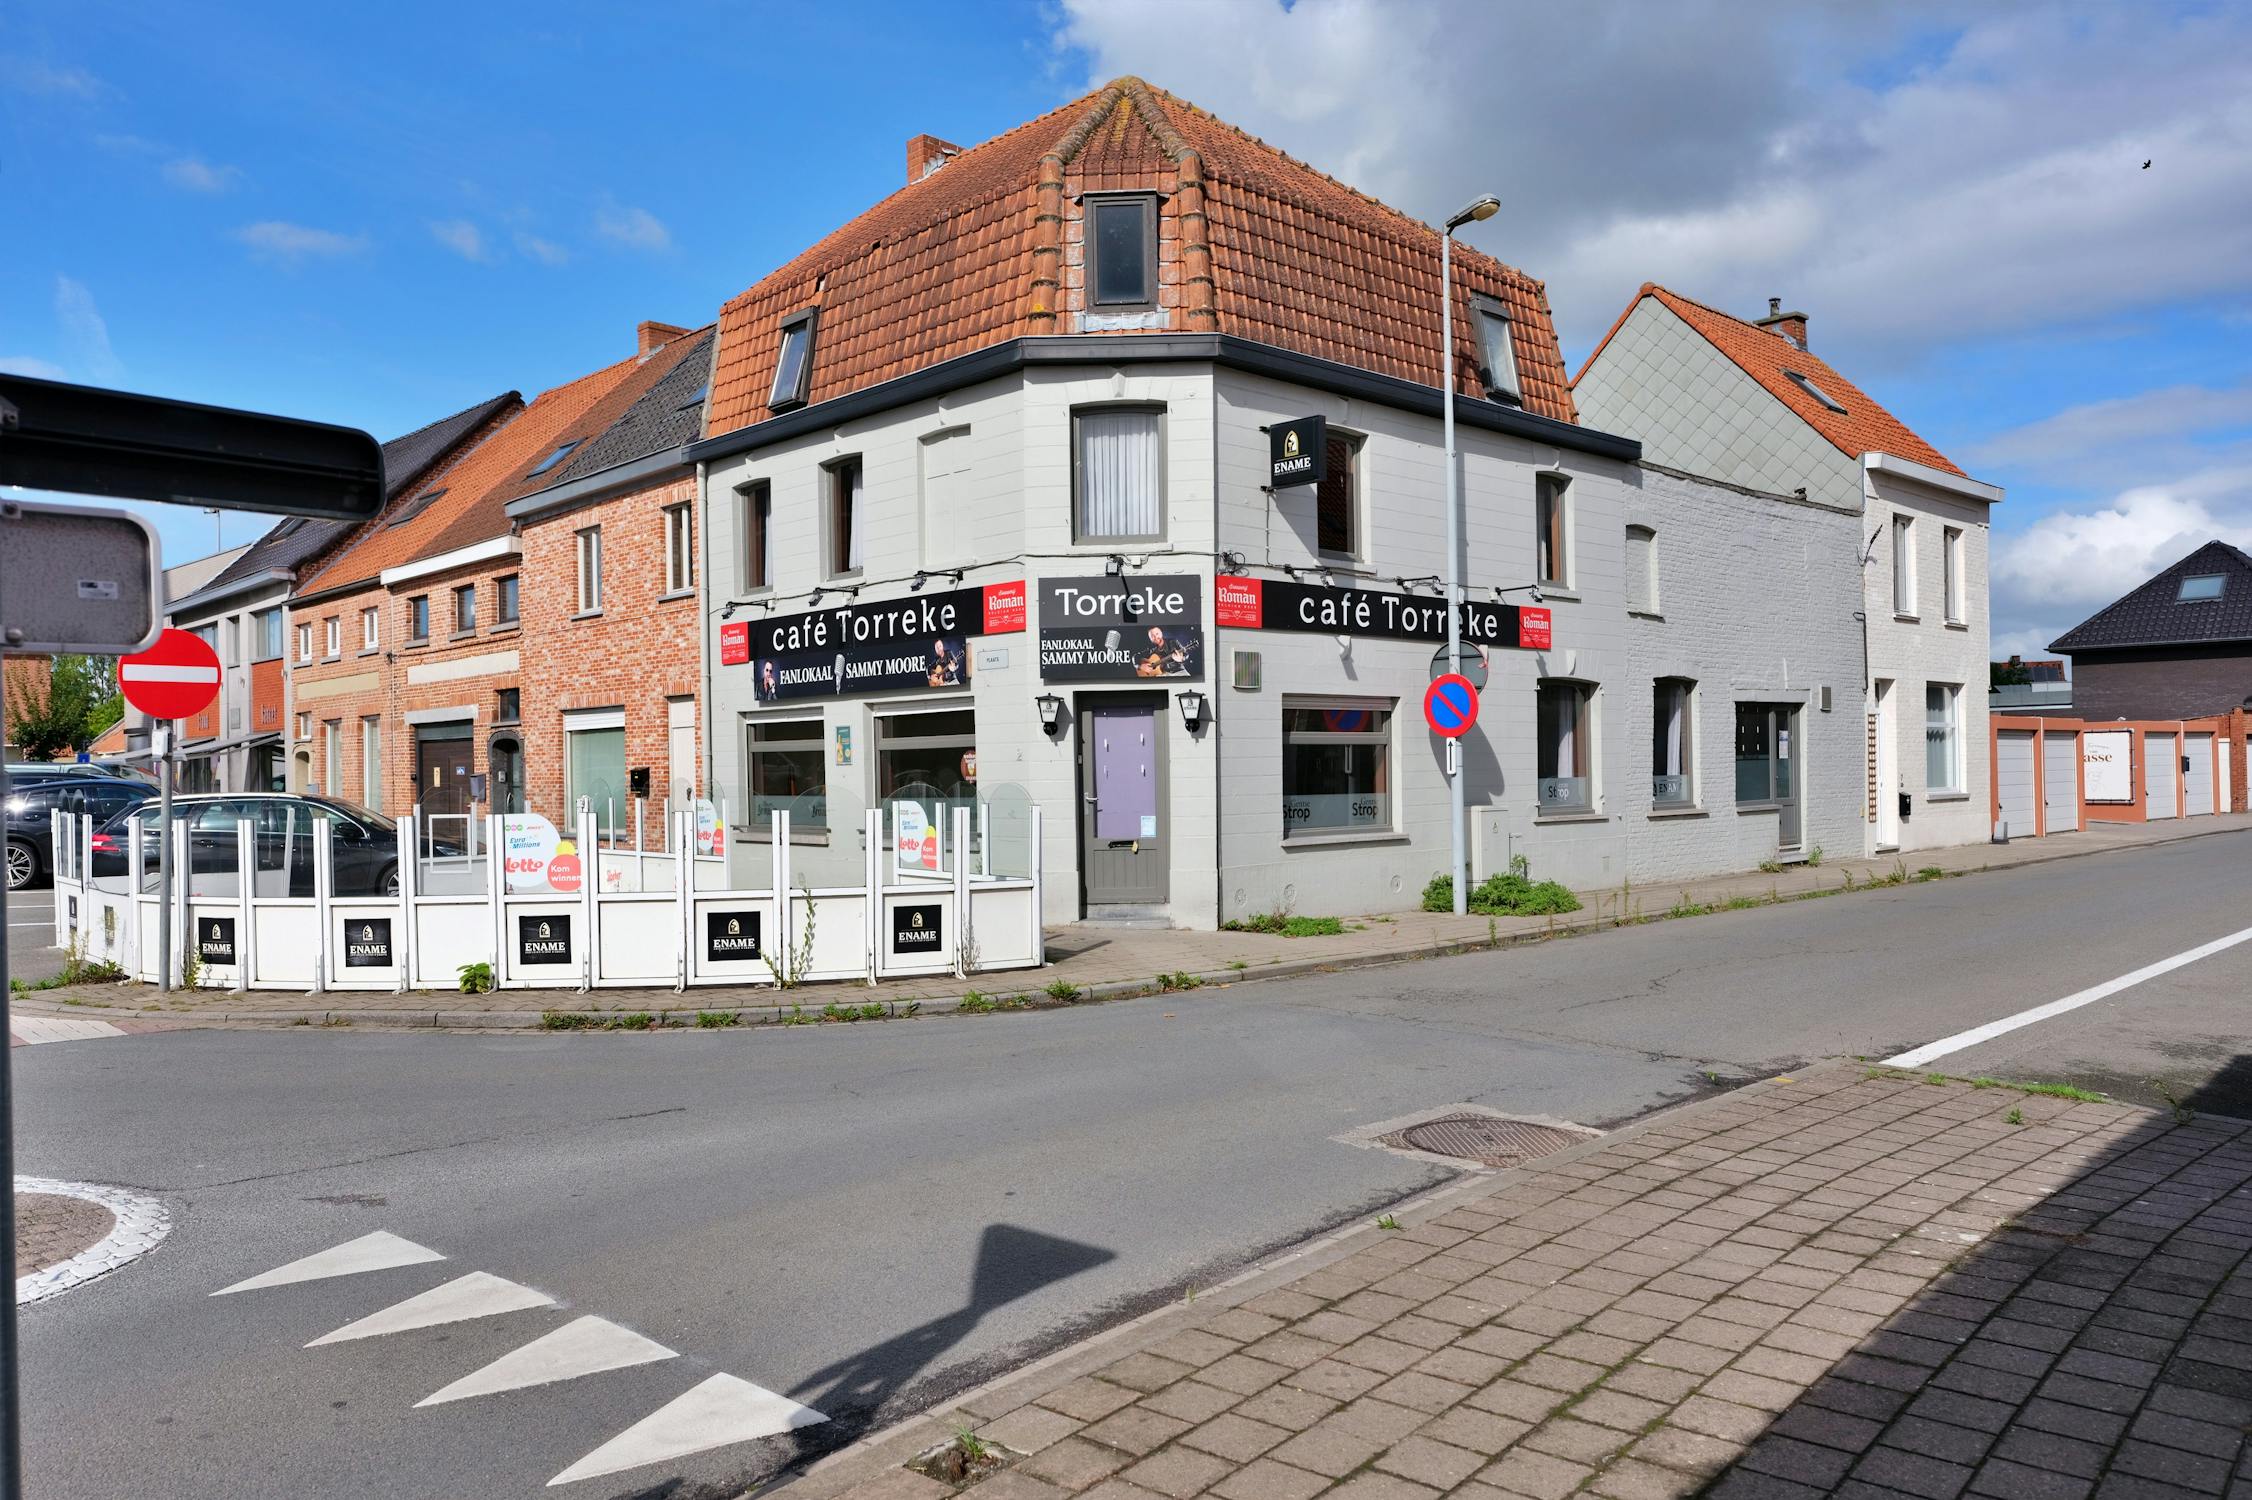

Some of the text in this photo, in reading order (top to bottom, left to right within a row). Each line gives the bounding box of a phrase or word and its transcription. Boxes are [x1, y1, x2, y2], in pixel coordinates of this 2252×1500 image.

[1274, 456, 1311, 474] ENAME
[989, 595, 1024, 610] Roman
[1055, 587, 1184, 616] Torreke
[1217, 586, 1257, 605] Roman
[1300, 593, 1371, 628] café
[773, 599, 956, 651] café Torreke
[1523, 615, 1549, 630] Roman
[723, 634, 745, 646] Roman
[1041, 639, 1094, 651] FANLOKAAL
[1042, 650, 1131, 665] SAMMY MOORE
[780, 656, 925, 686] FANLOKAAL SAMMY MOORE
[1283, 805, 1311, 822] Strop
[1352, 802, 1379, 819] Strop
[551, 865, 570, 873] Kom
[713, 938, 755, 948] ENAME
[898, 930, 937, 941] ENAME
[202, 943, 232, 952] ENAME
[350, 945, 387, 954] ENAME
[524, 942, 566, 951] ENAME
